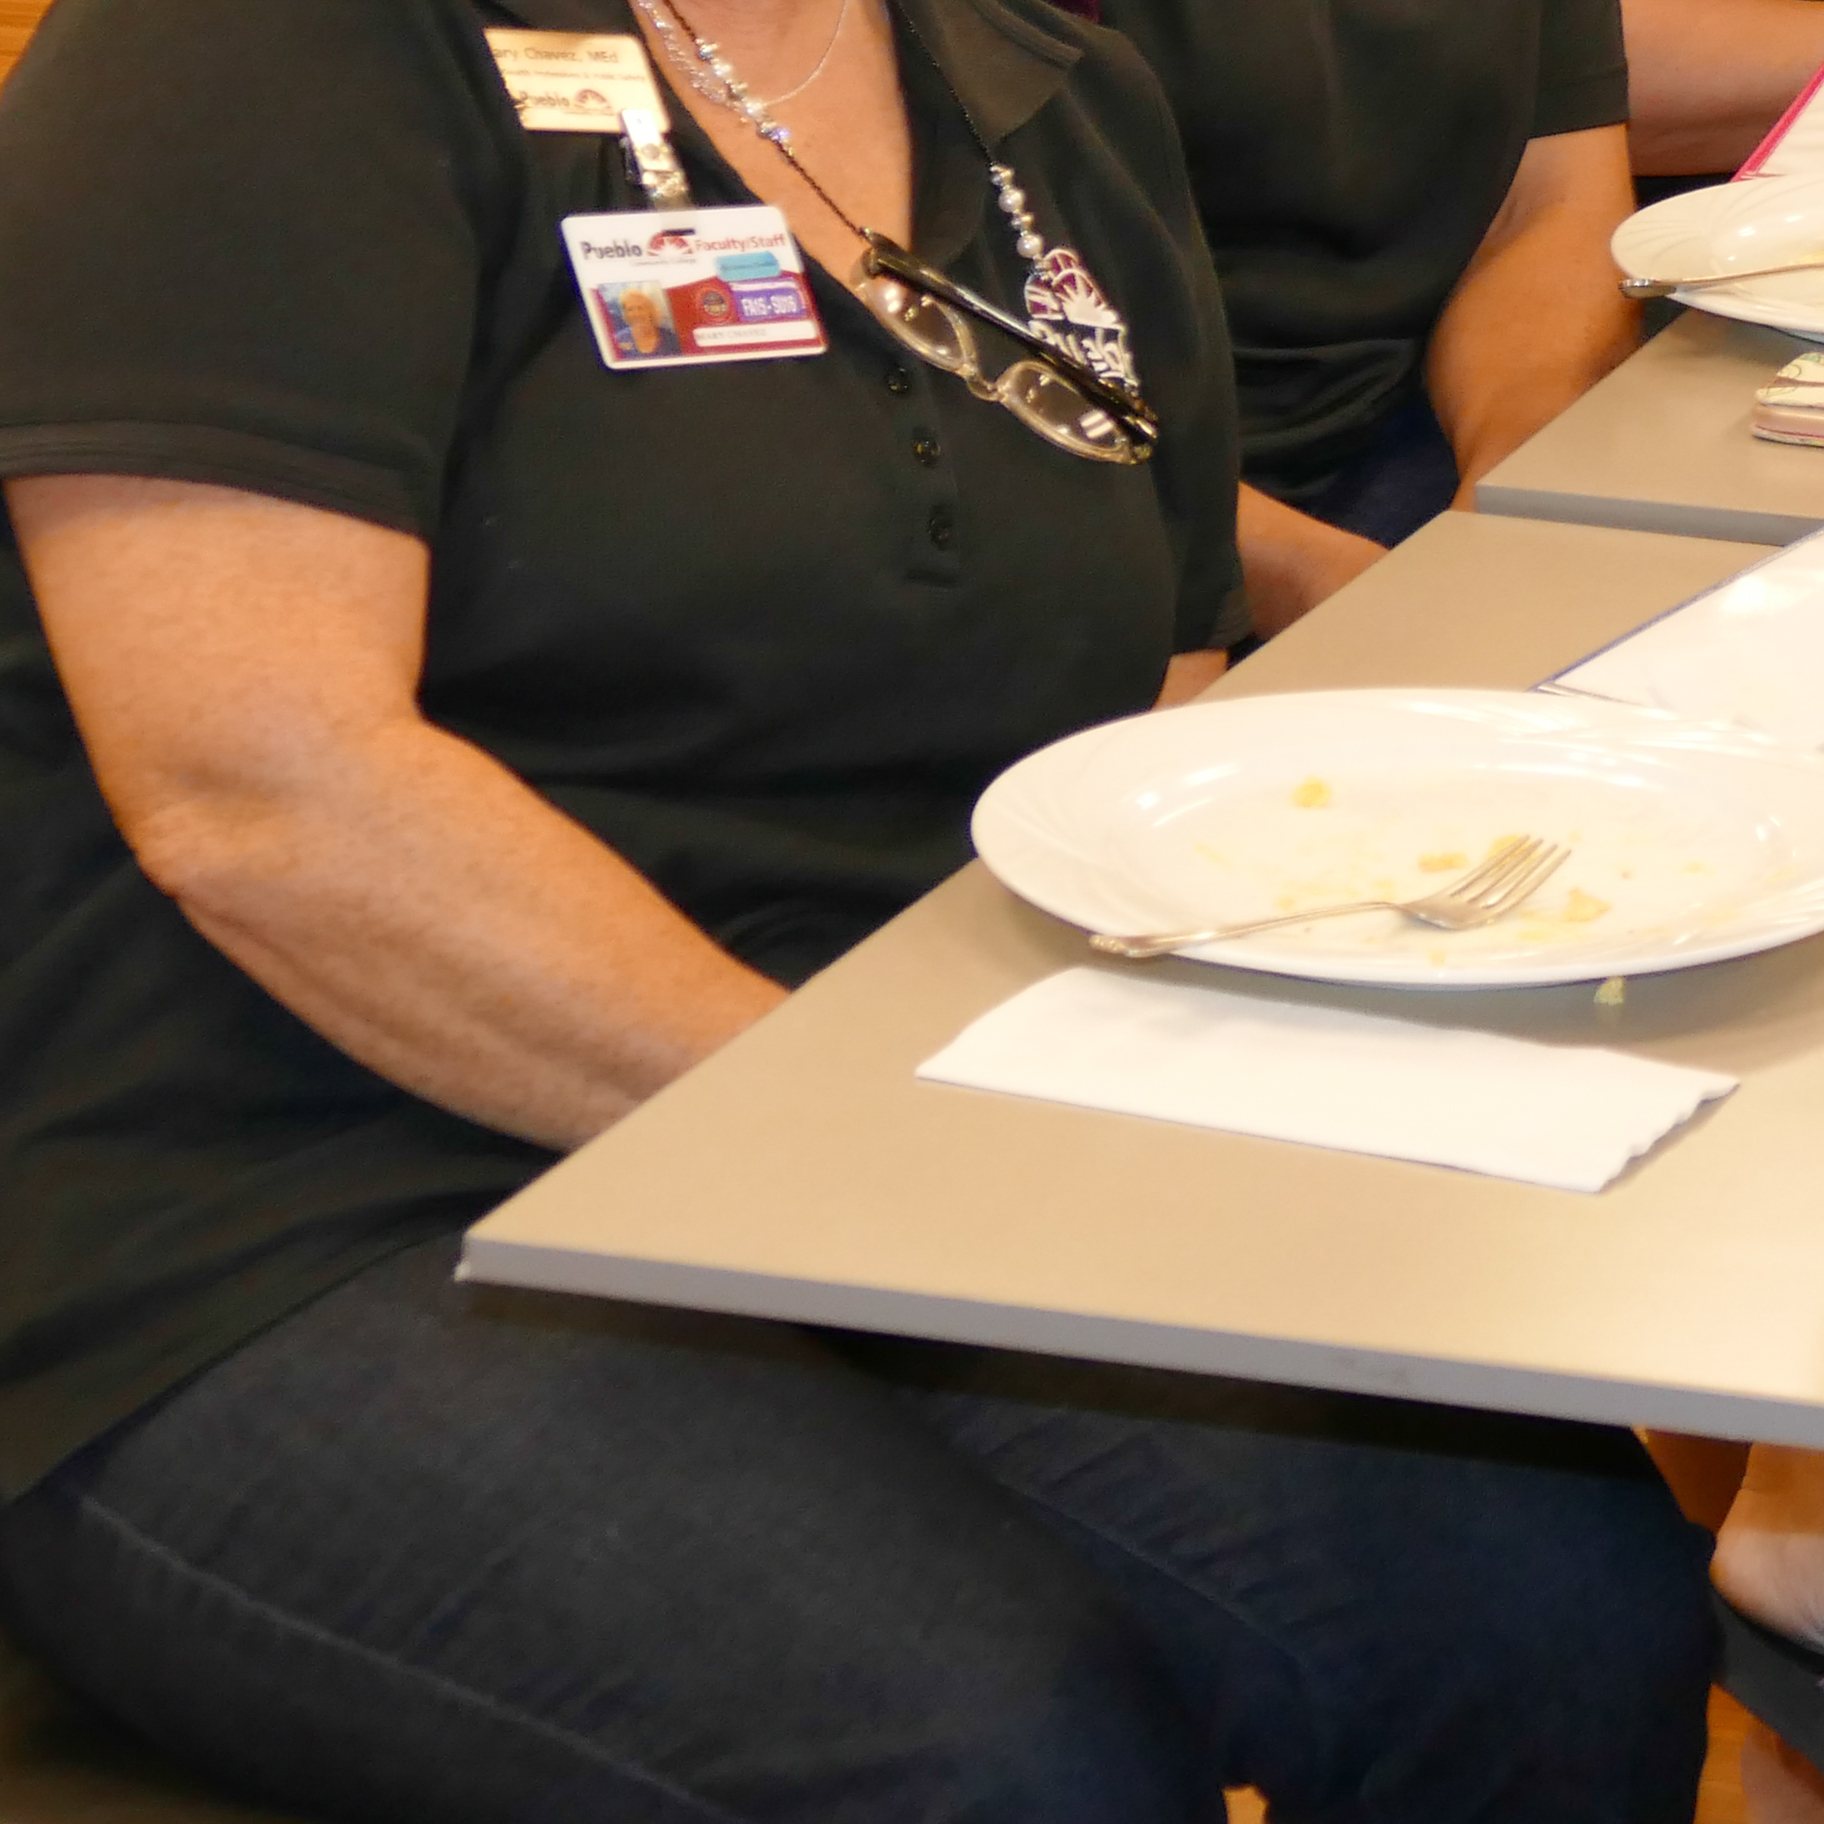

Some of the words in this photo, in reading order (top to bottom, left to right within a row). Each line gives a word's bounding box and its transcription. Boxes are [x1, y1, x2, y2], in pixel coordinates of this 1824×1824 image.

[492, 47, 518, 61] ary
[581, 239, 643, 260] Pueblo
[695, 233, 788, 253] Faculty/Staff
